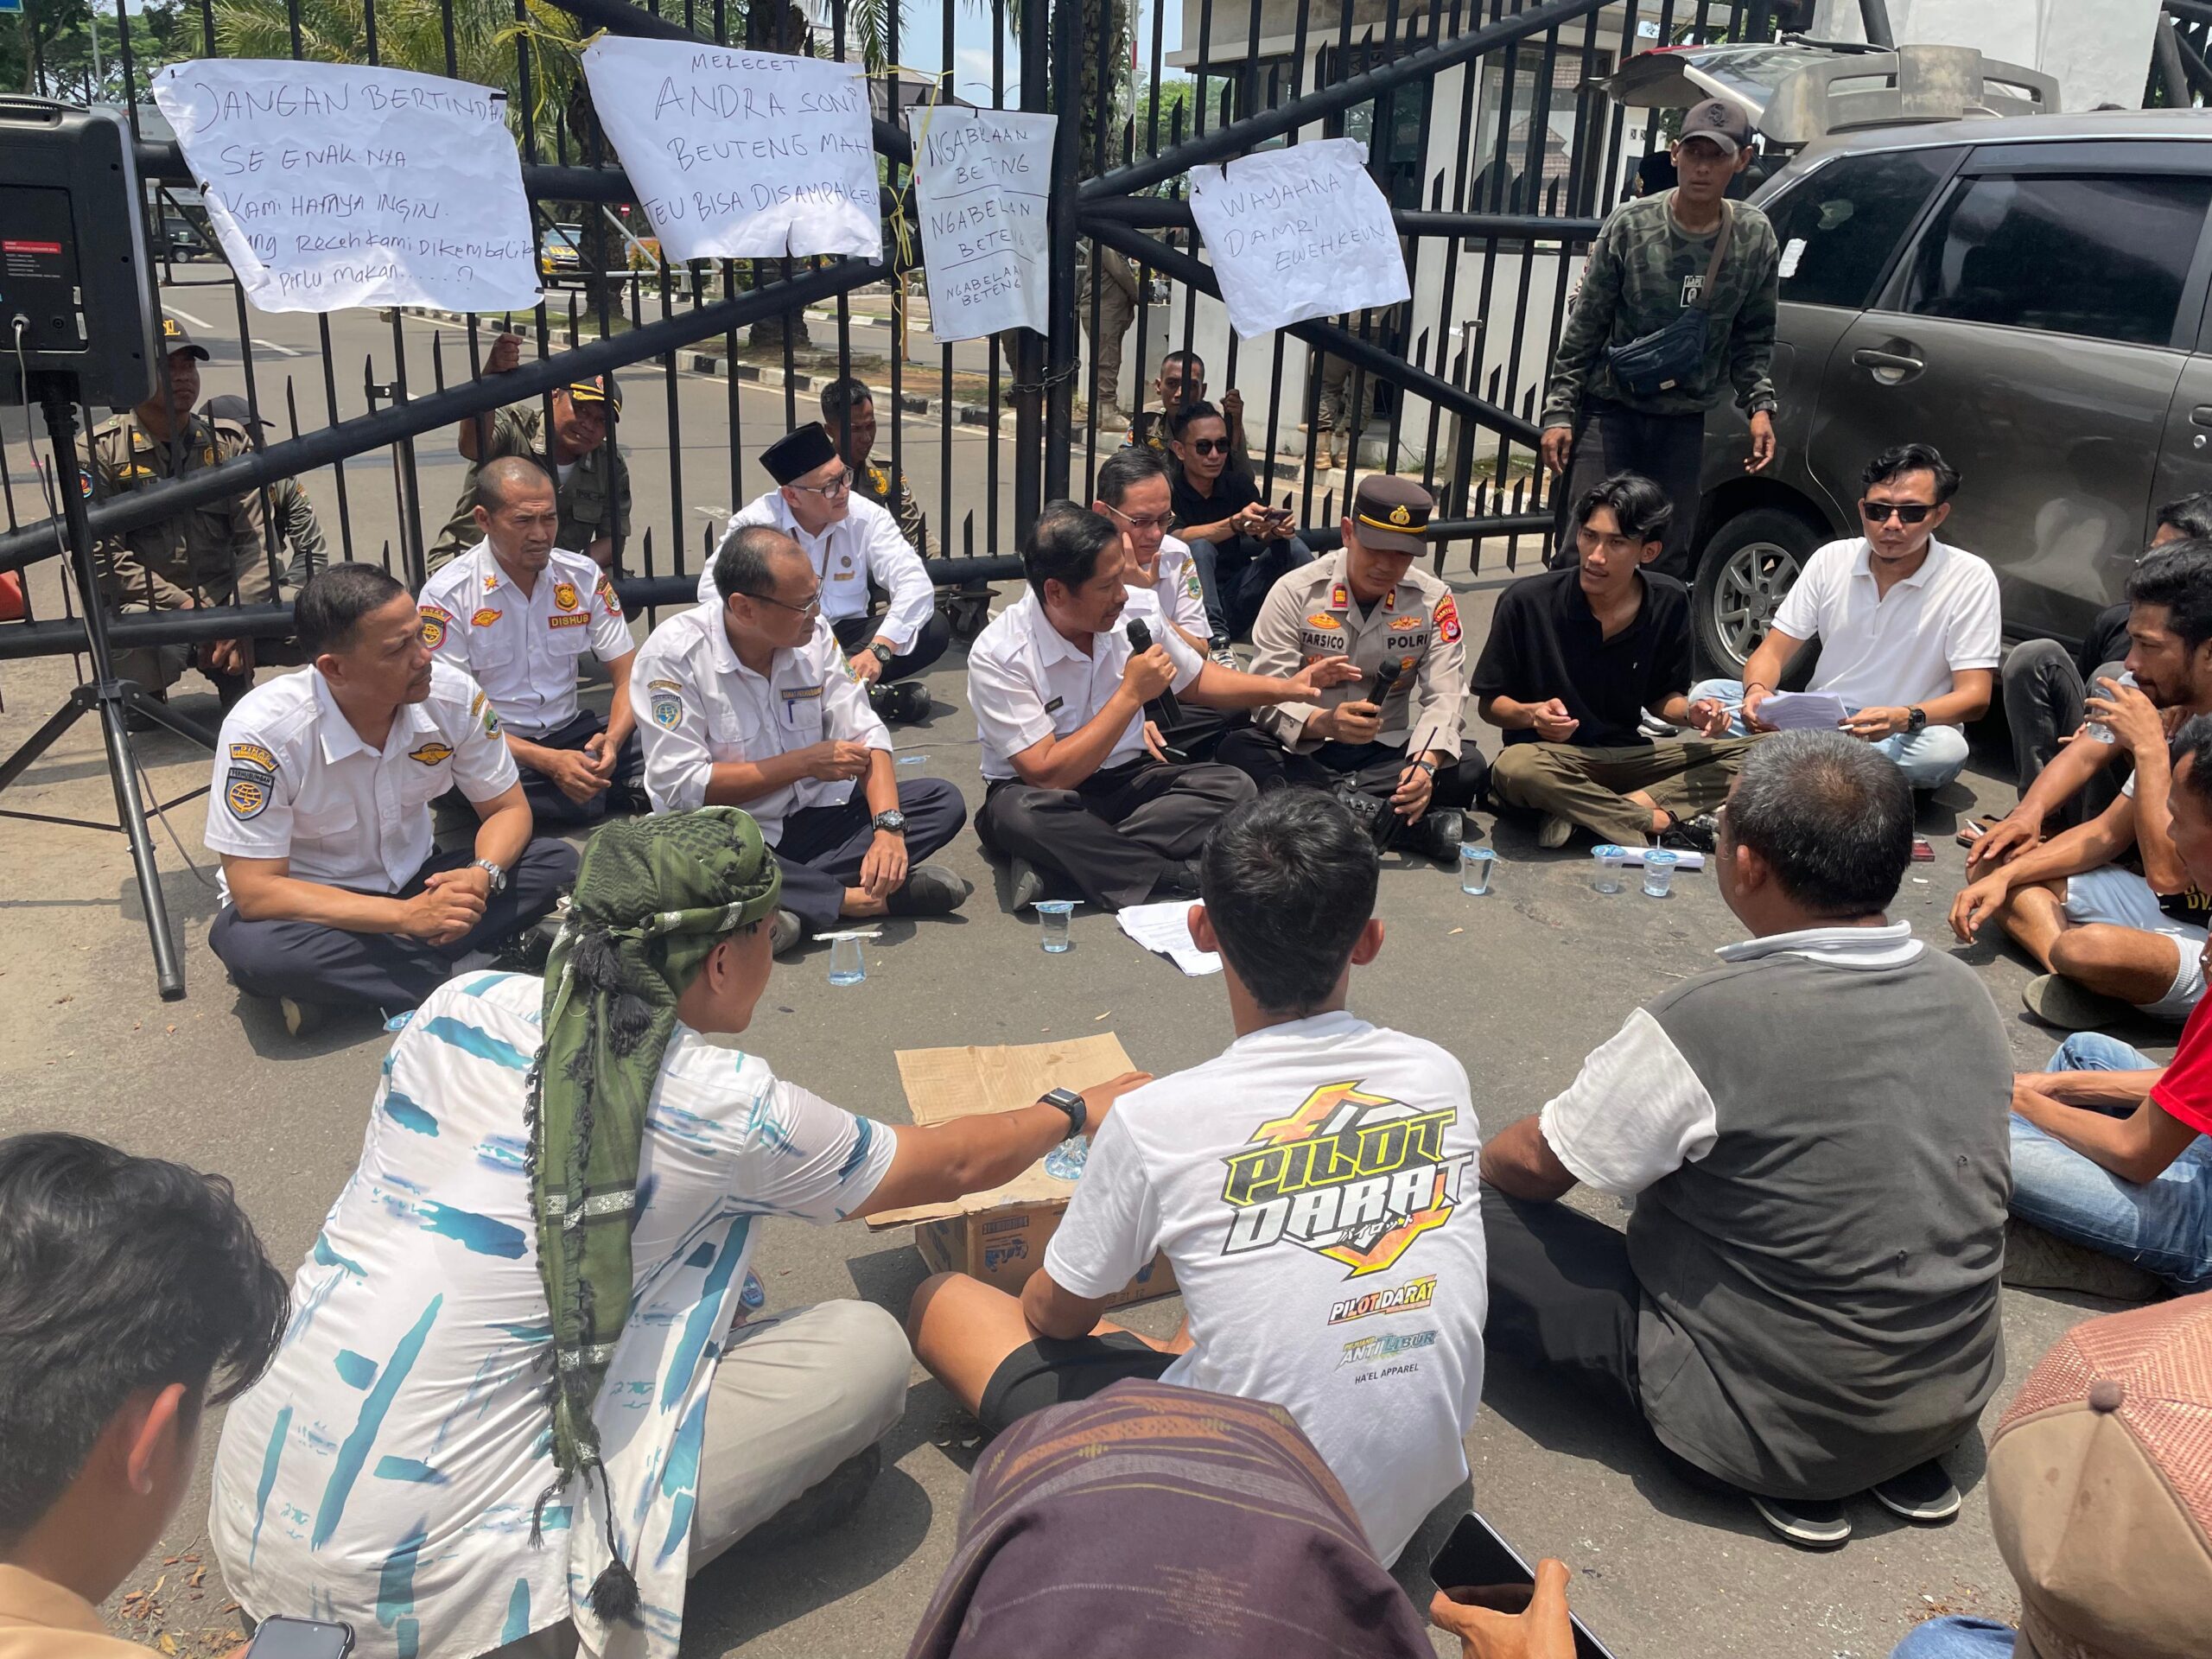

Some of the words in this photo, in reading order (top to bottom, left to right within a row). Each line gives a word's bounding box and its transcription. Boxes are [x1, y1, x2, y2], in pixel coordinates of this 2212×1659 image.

[194, 82, 349, 133] JANGAN
[655, 76, 787, 120] ANDRA
[220, 145, 264, 175] SE
[666, 134, 808, 171] BEUTENG
[821, 133, 869, 157] MAH
[642, 198, 684, 229] TEU
[693, 190, 744, 221] BISA
[1220, 173, 1342, 218] WAYAHNA
[1224, 214, 1319, 257] DAMRI
[1275, 218, 1386, 271] EWEHKEUN
[961, 278, 1021, 307] BETENG
[550, 614, 589, 626] DISHUB
[1301, 632, 1344, 649] TARSICO
[1387, 633, 1427, 650] POLRI
[1221, 1107, 1457, 1206] PILOT
[1221, 1151, 1474, 1255] DARAT
[1329, 1293, 1380, 1321] PILOT
[1380, 1279, 1437, 1309] DARAT
[1354, 1371, 1378, 1384] HA'EL
[1381, 1363, 1420, 1378] APPAREL
